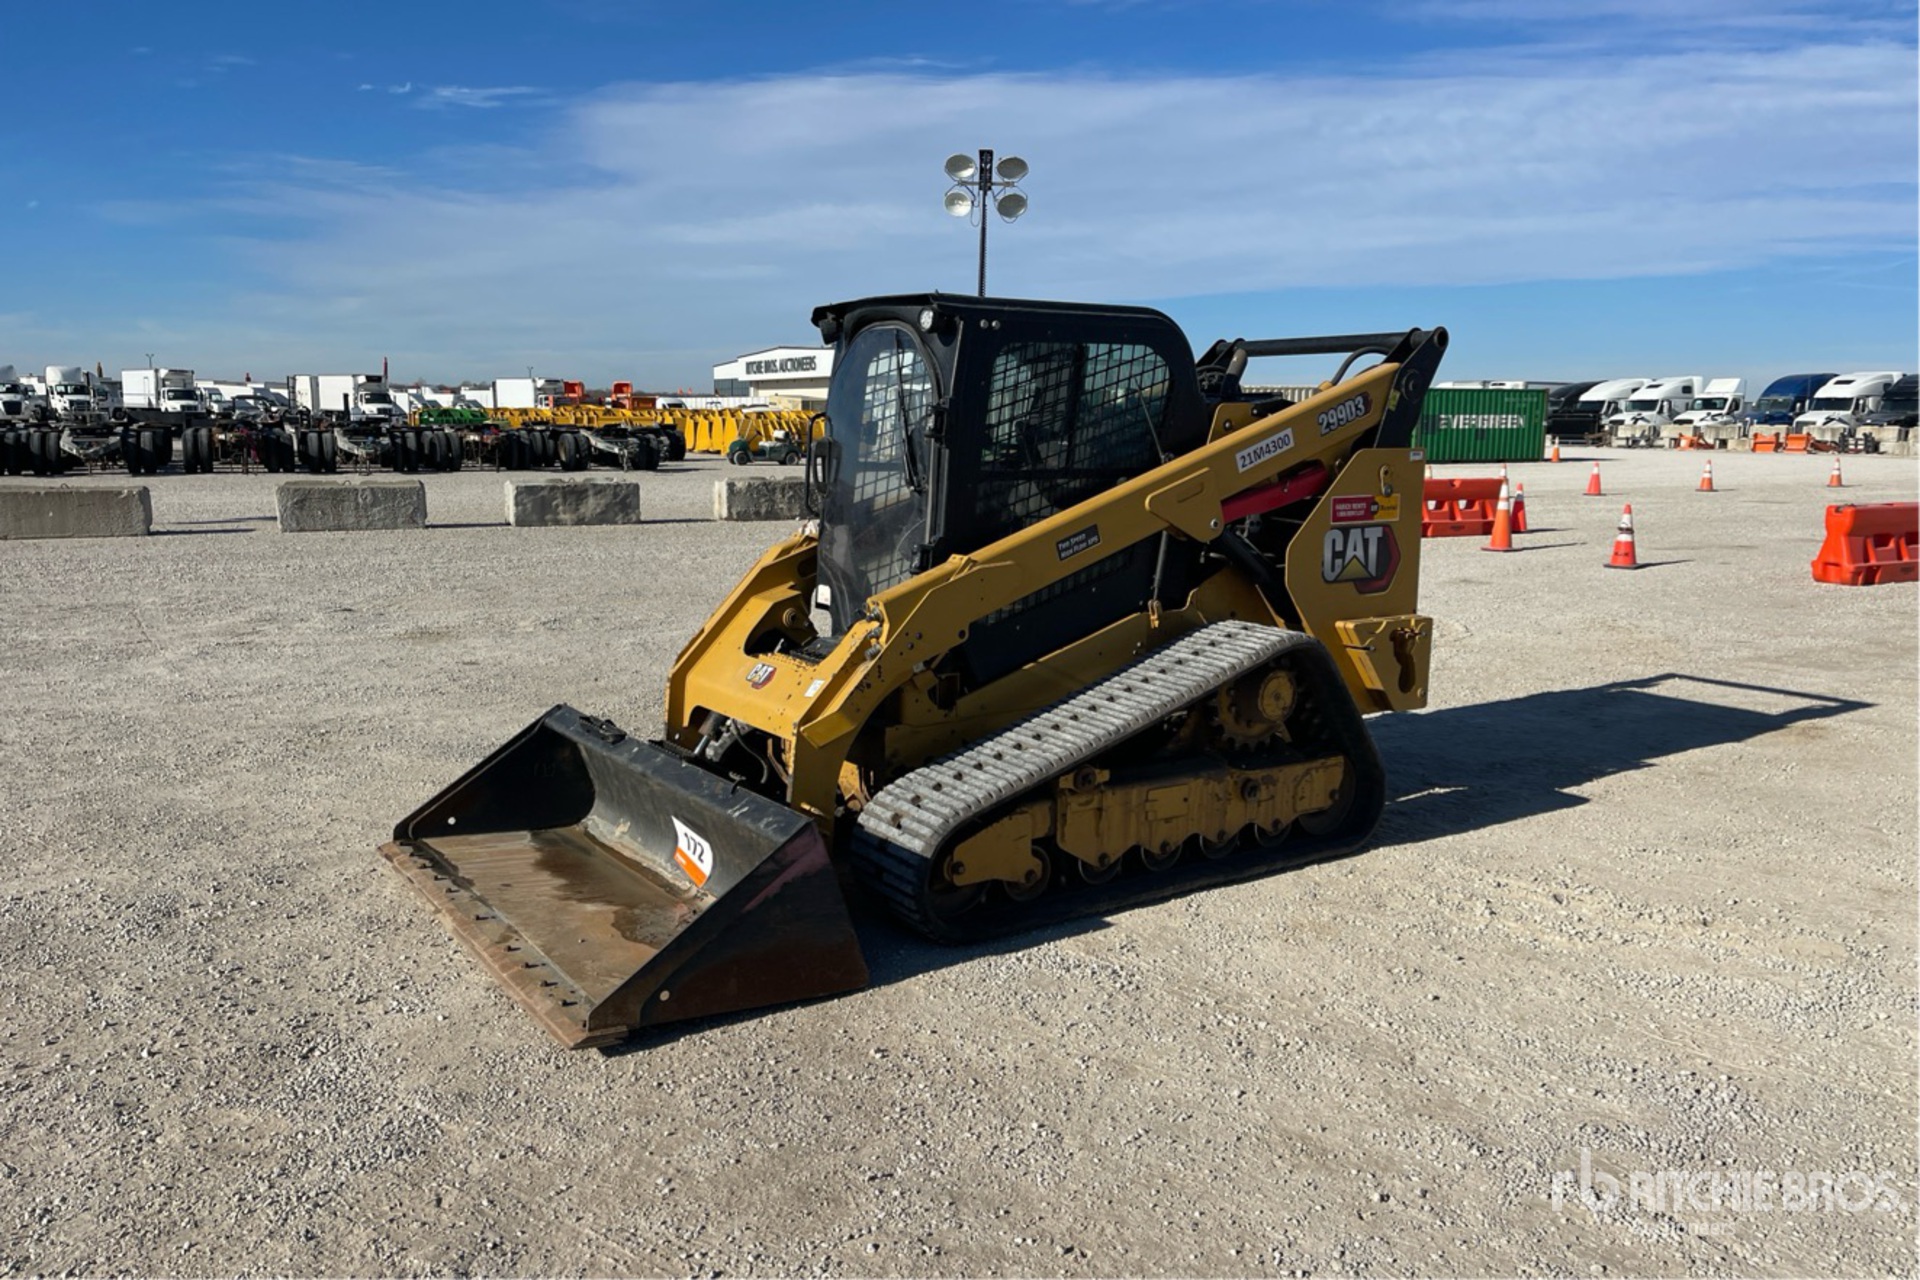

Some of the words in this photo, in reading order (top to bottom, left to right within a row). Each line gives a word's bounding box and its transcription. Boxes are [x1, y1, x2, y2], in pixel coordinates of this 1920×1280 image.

[1318, 395, 1365, 435] 299D3
[1439, 413, 1525, 429] EVERGREEN
[1240, 433, 1291, 469] 21M4300
[1323, 526, 1383, 582] CAT
[746, 663, 775, 684] CAT
[684, 832, 704, 864] 172
